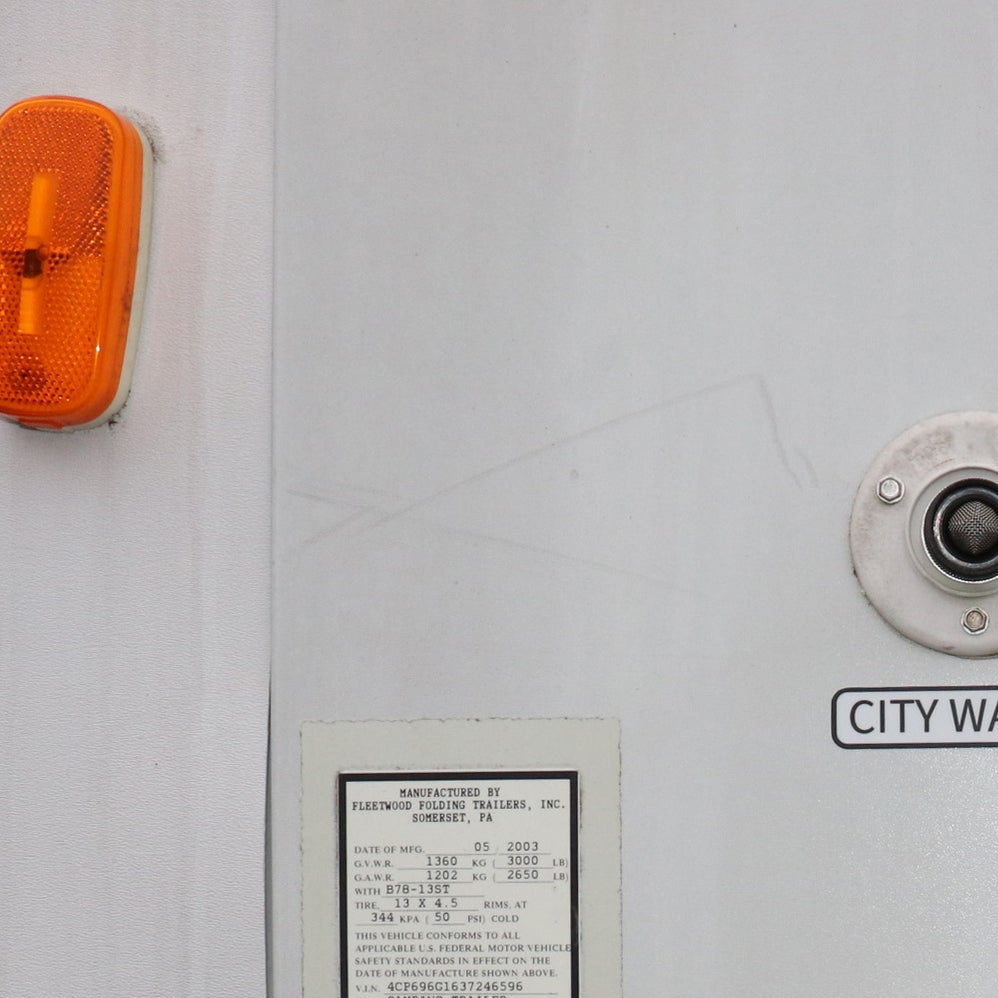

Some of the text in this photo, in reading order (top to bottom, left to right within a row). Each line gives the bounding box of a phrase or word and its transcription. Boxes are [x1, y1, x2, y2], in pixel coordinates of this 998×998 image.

[850, 699, 939, 734] CITY
[399, 787, 501, 798] MANUFACTURED BY
[352, 799, 565, 811] FLEETWOOD FOLDING TRAILERS, INC.
[412, 812, 493, 824] SOMERSET, PA
[354, 841, 539, 854] DATE OF MFG. 05 2003
[426, 856, 458, 867] 1360
[472, 859, 487, 867] KG
[507, 855, 539, 866] 3000
[426, 870, 458, 880] 1202
[472, 873, 487, 881] KG
[507, 869, 539, 880] 2650
[355, 884, 450, 896] WITH B78-13ST
[395, 898, 410, 908] 13
[418, 898, 426, 908] X
[434, 898, 458, 908] 4.5
[514, 901, 528, 909] AT
[371, 912, 394, 922] 344
[399, 915, 420, 923] KPA
[434, 912, 450, 922] 50
[491, 915, 519, 923] COLD
[355, 931, 521, 940] THIS VEHICLE CONFORMS TO ALL
[355, 944, 416, 952] APPLICABLE
[439, 944, 485, 952] FEDERAL
[487, 944, 524, 952] MOTOR
[527, 944, 572, 952] VEHICLE
[355, 957, 391, 965] SAFETY
[395, 957, 455, 965] STANDARDS
[458, 957, 469, 965] IN
[473, 957, 509, 965] EFFECT
[512, 957, 527, 965] ON
[401, 969, 479, 977] MANUFACTURE
[481, 969, 518, 977] SHOWN
[521, 969, 558, 977] ABOVE.
[387, 981, 523, 992] 4CP696G1637246596
